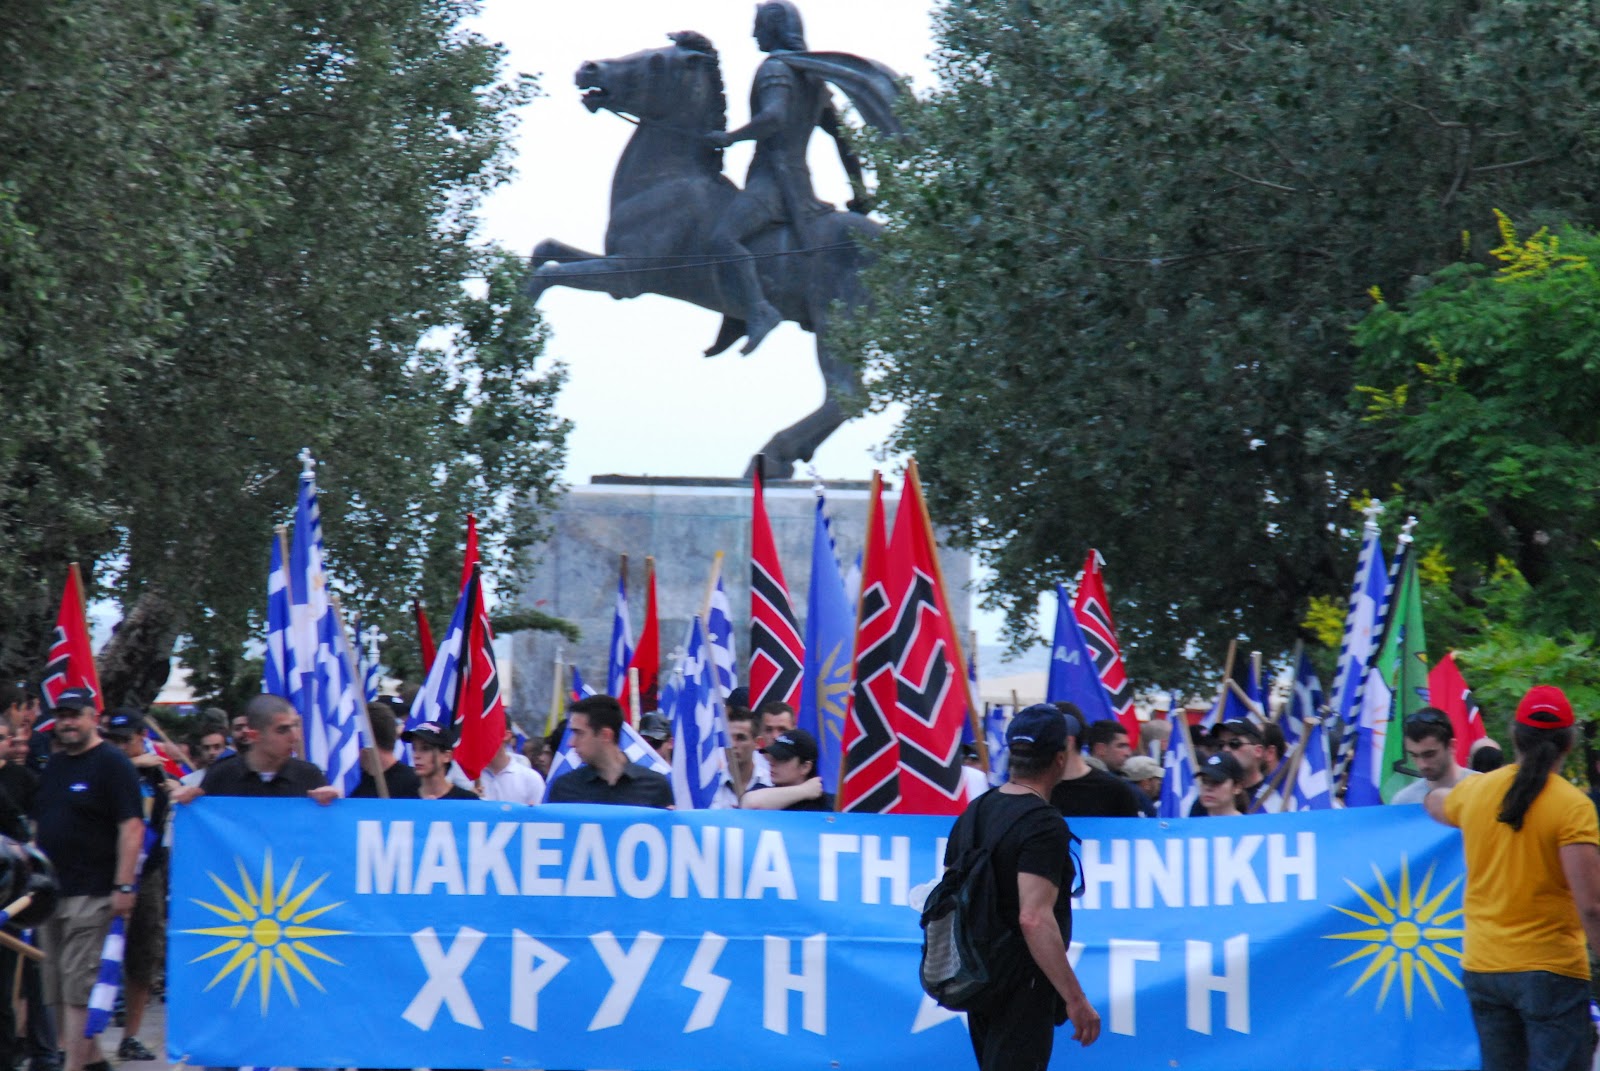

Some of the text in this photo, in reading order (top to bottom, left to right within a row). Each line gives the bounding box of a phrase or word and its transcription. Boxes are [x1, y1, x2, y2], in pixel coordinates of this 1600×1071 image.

[356, 820, 1317, 909] ΜΑΚΕΔΟΝΙΑ ΓΗ ΗΝΙΚΗ
[911, 934, 1250, 1036] ΓΗ
